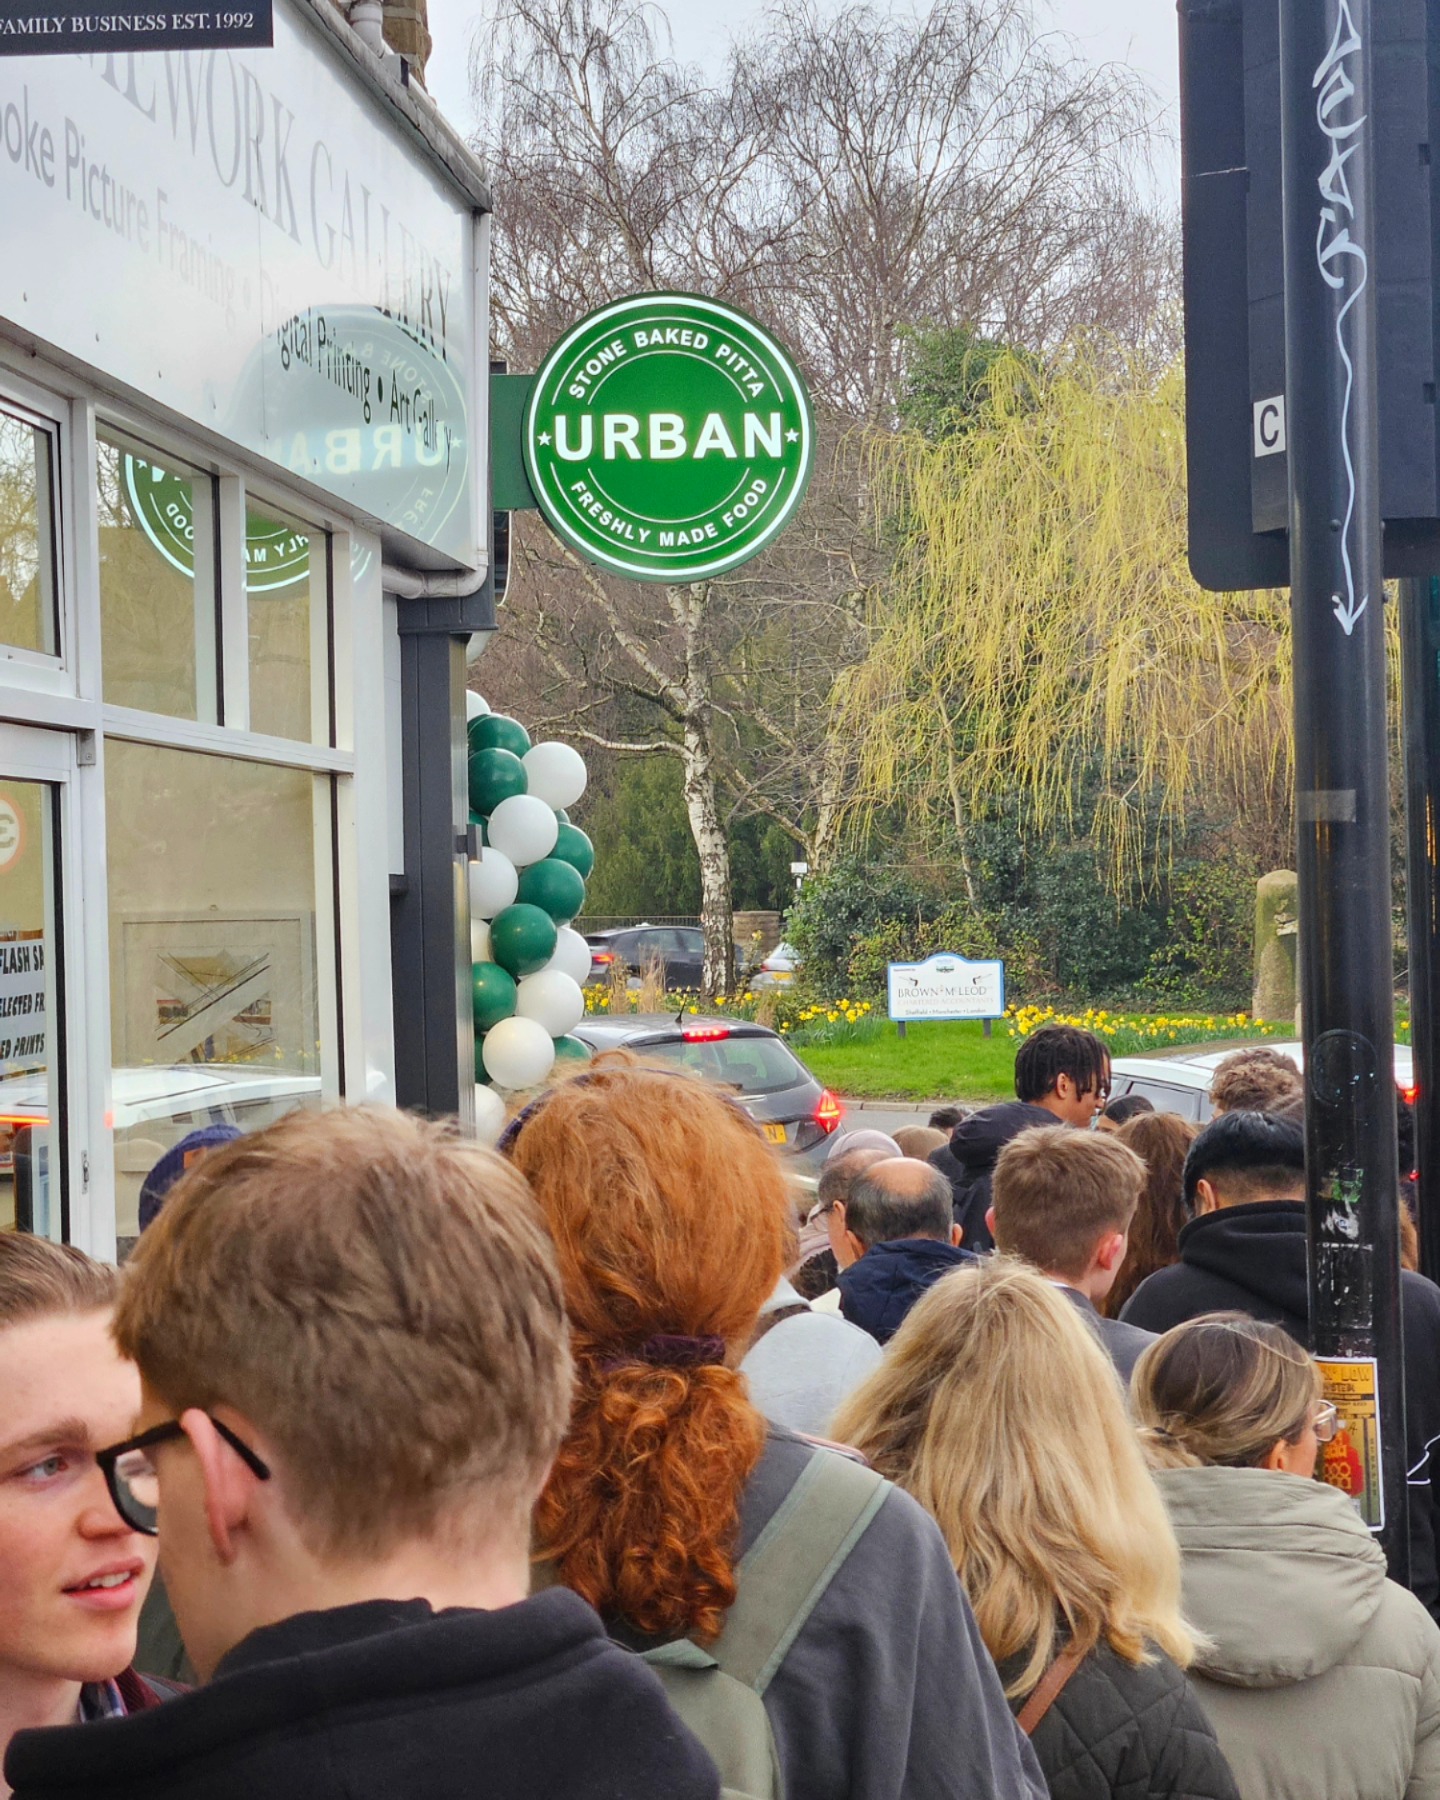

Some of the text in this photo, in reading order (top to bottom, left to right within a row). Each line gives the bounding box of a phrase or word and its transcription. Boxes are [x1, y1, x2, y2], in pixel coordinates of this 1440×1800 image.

[71, 14, 167, 33] BUSINESS
[172, 13, 210, 30] EST.
[215, 12, 254, 29] 1992
[0, 84, 55, 188] oke
[65, 116, 150, 255] Picture
[157, 186, 237, 336] Framing
[318, 314, 371, 424] Printing
[390, 369, 411, 434] Art
[568, 328, 766, 399] STONE BAKED PITTA
[554, 412, 782, 461] URBAN
[1259, 404, 1278, 447] C
[571, 479, 767, 547] FRESHLY MADE FOOD
[898, 987, 939, 998] BROWN
[13, 1033, 45, 1058] PRINTS
